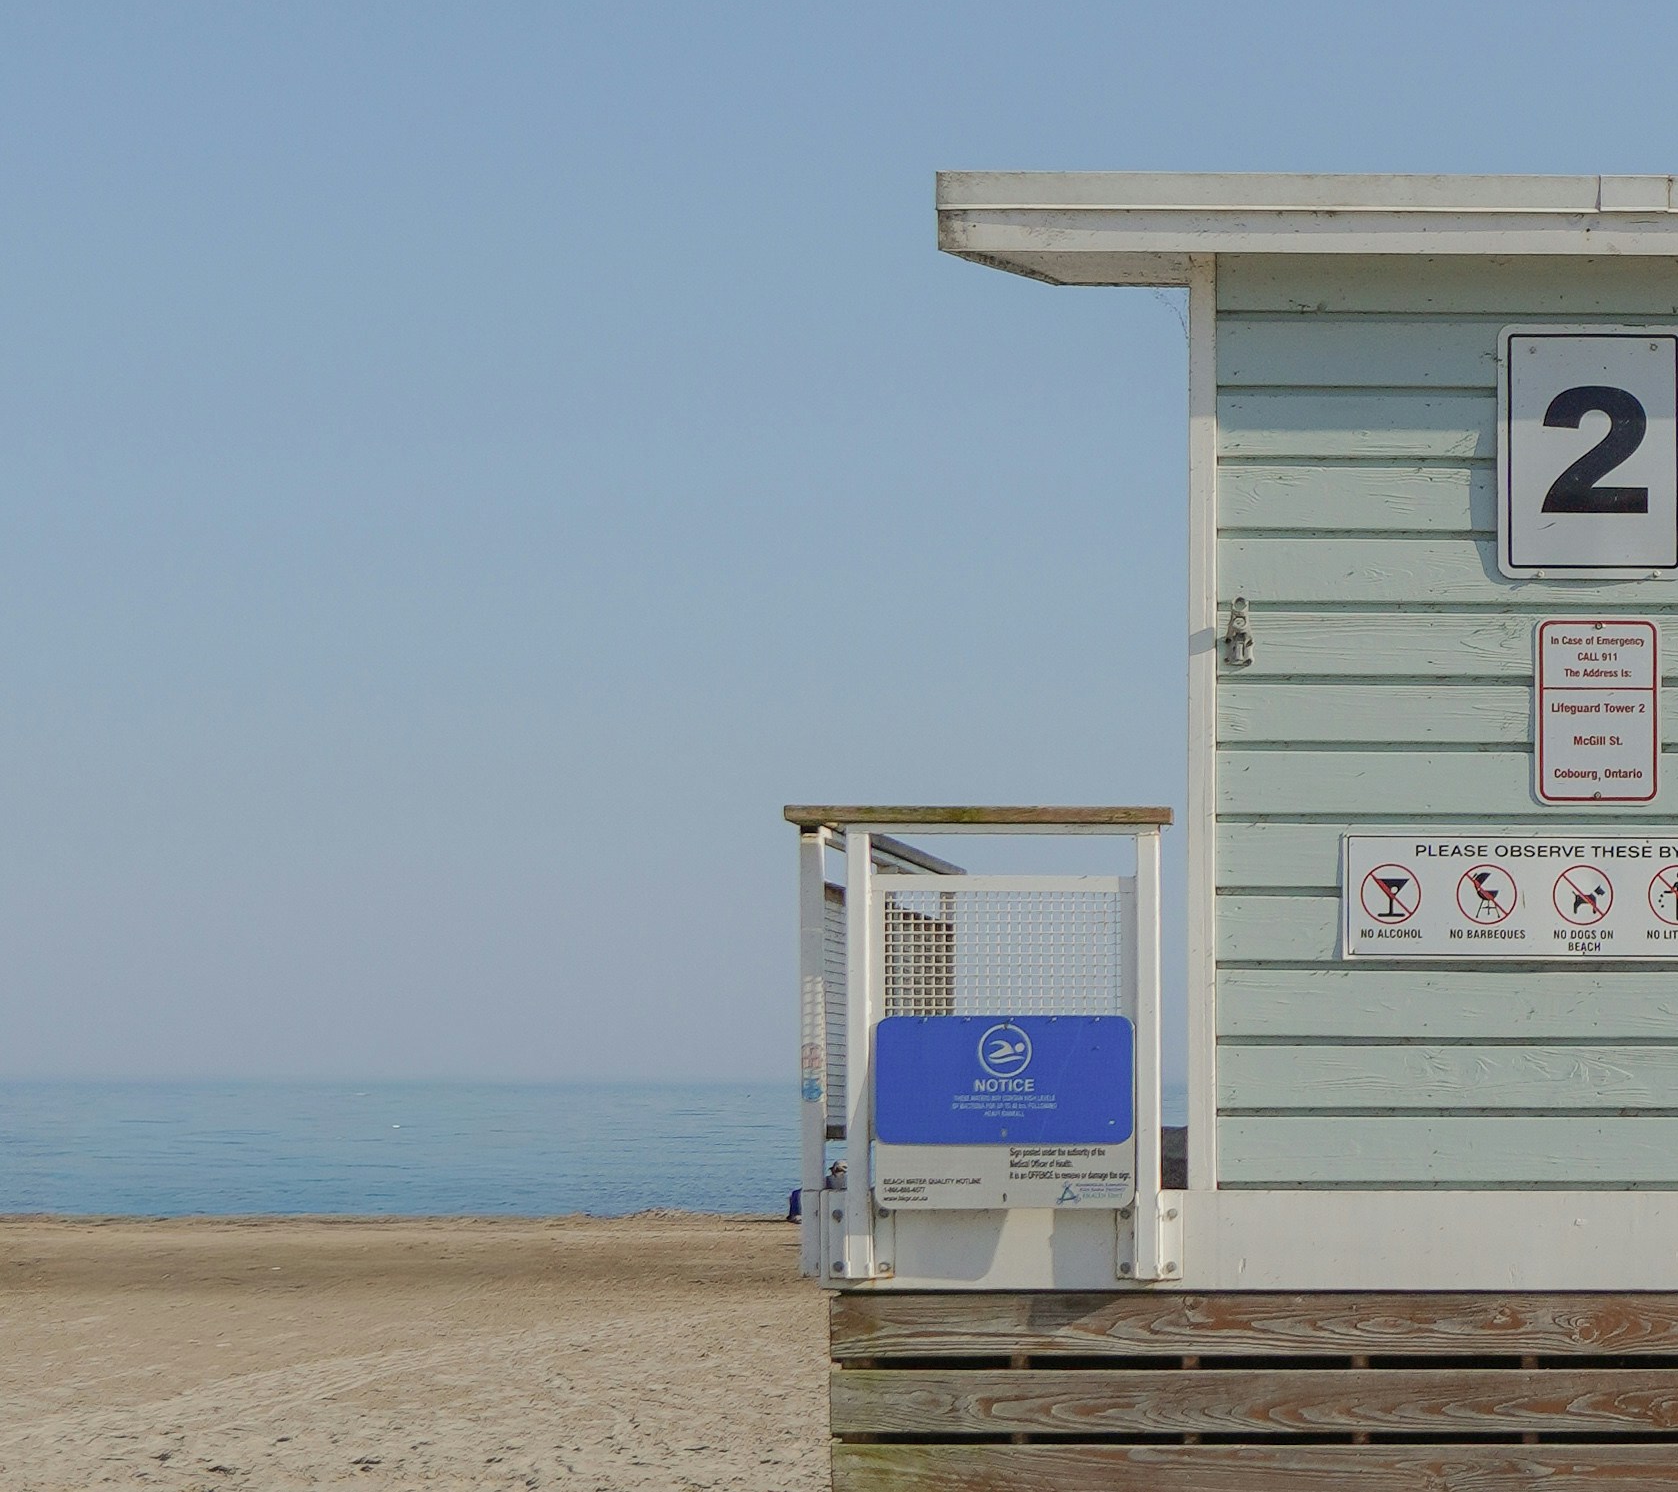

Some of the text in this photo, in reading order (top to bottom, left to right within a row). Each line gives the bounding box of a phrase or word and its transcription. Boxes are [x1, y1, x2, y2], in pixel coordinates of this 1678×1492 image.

[1540, 385, 1649, 513] 2
[1551, 636, 1645, 647] In Case of Emergency
[1578, 653, 1618, 661] CALL 911
[1564, 668, 1632, 678] The Address Is:
[1552, 703, 1645, 715] Lifeguard Tower 2
[1574, 736, 1623, 746] McGill St.
[1554, 768, 1642, 782] Cobourg, Ontario
[1416, 845, 1488, 858] PLEASE
[1495, 845, 1585, 858] OBSERVE
[1591, 846, 1652, 858] THESE
[1360, 929, 1422, 939] NO ALCOHOL
[1450, 930, 1526, 940] NO BARBEQUES
[1554, 930, 1614, 940] NO DOGS ON
[1646, 930, 1660, 940] NO
[1568, 942, 1601, 952] BEACH
[974, 1078, 1035, 1092] NOTICE
